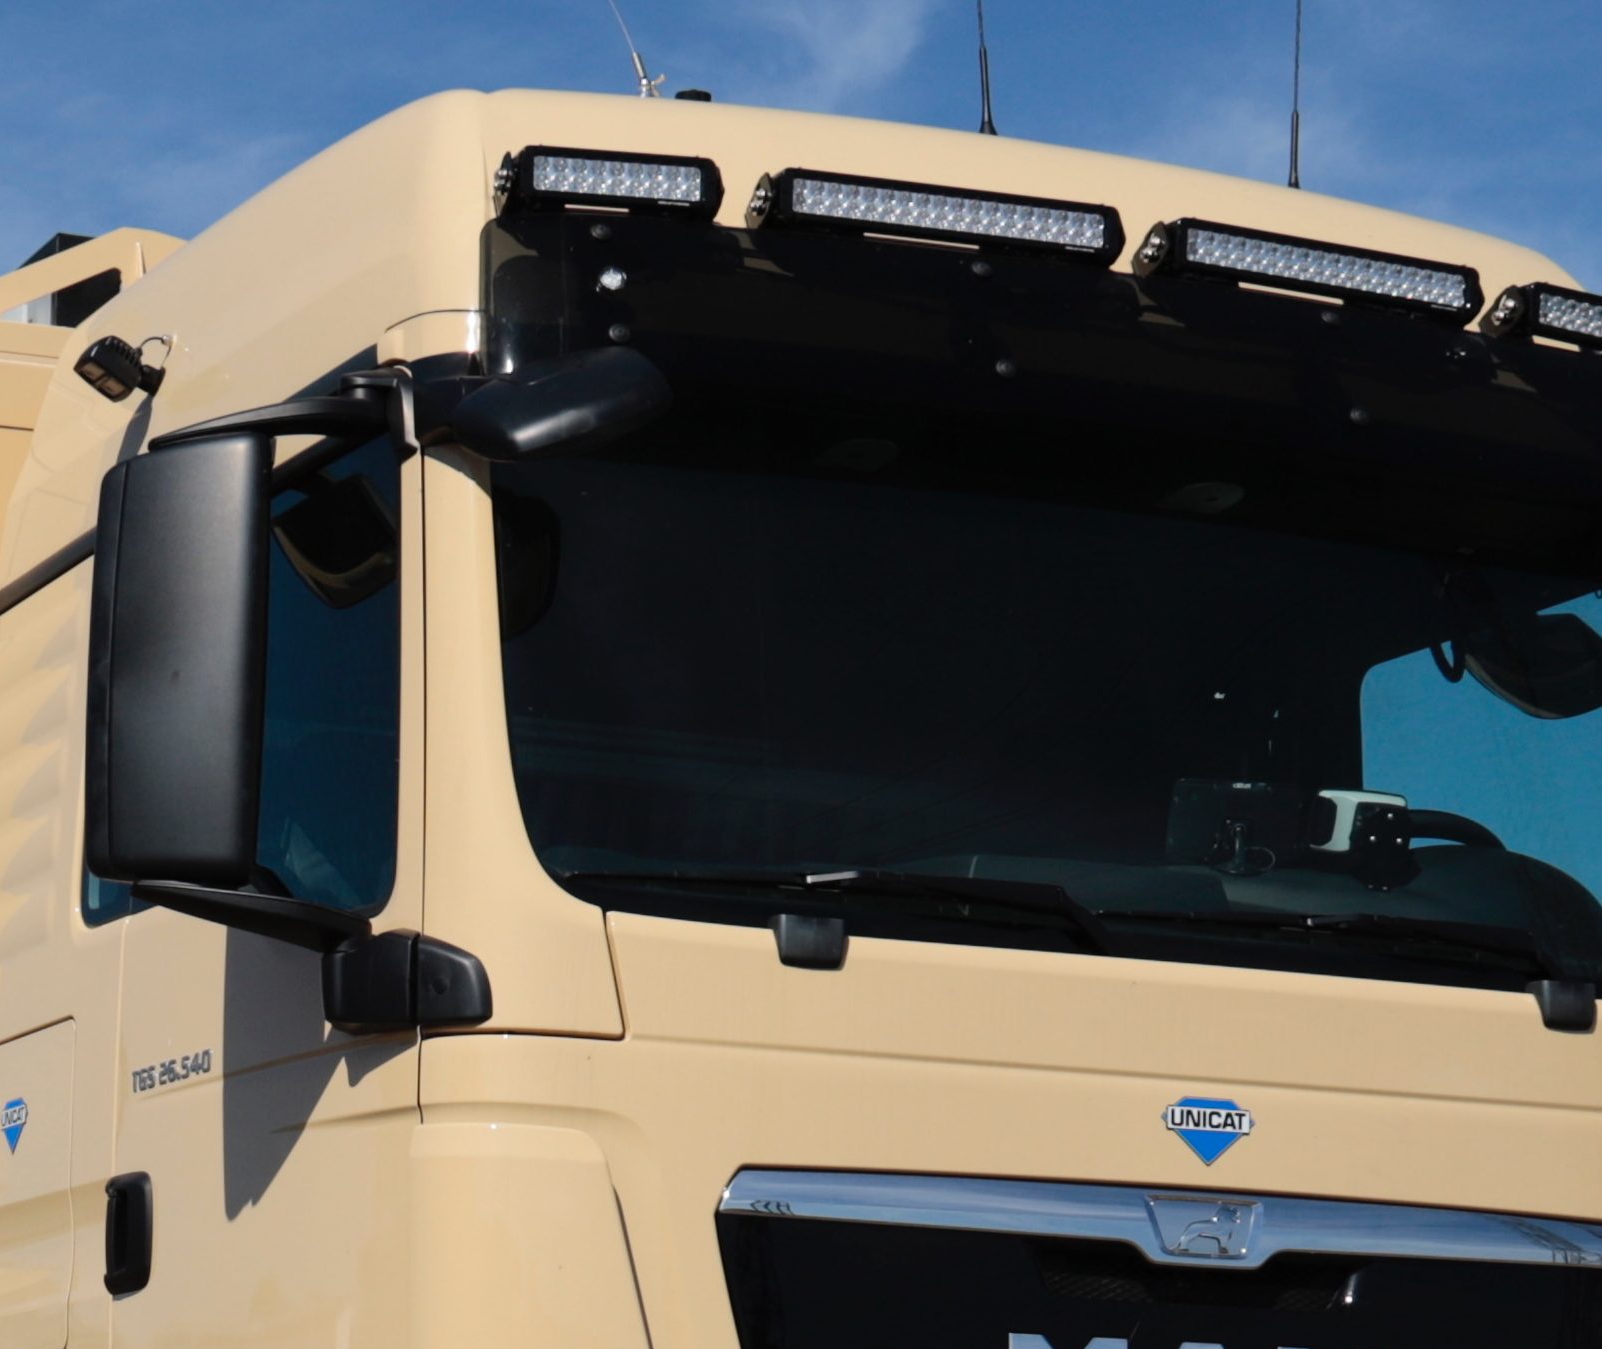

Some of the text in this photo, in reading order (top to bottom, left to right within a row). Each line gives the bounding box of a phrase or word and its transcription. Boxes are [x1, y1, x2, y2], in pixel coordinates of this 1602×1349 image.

[132, 1048, 211, 1093] TGS 26.540
[1, 1106, 25, 1127] UNICAT
[1170, 1107, 1247, 1131] UNICAT
